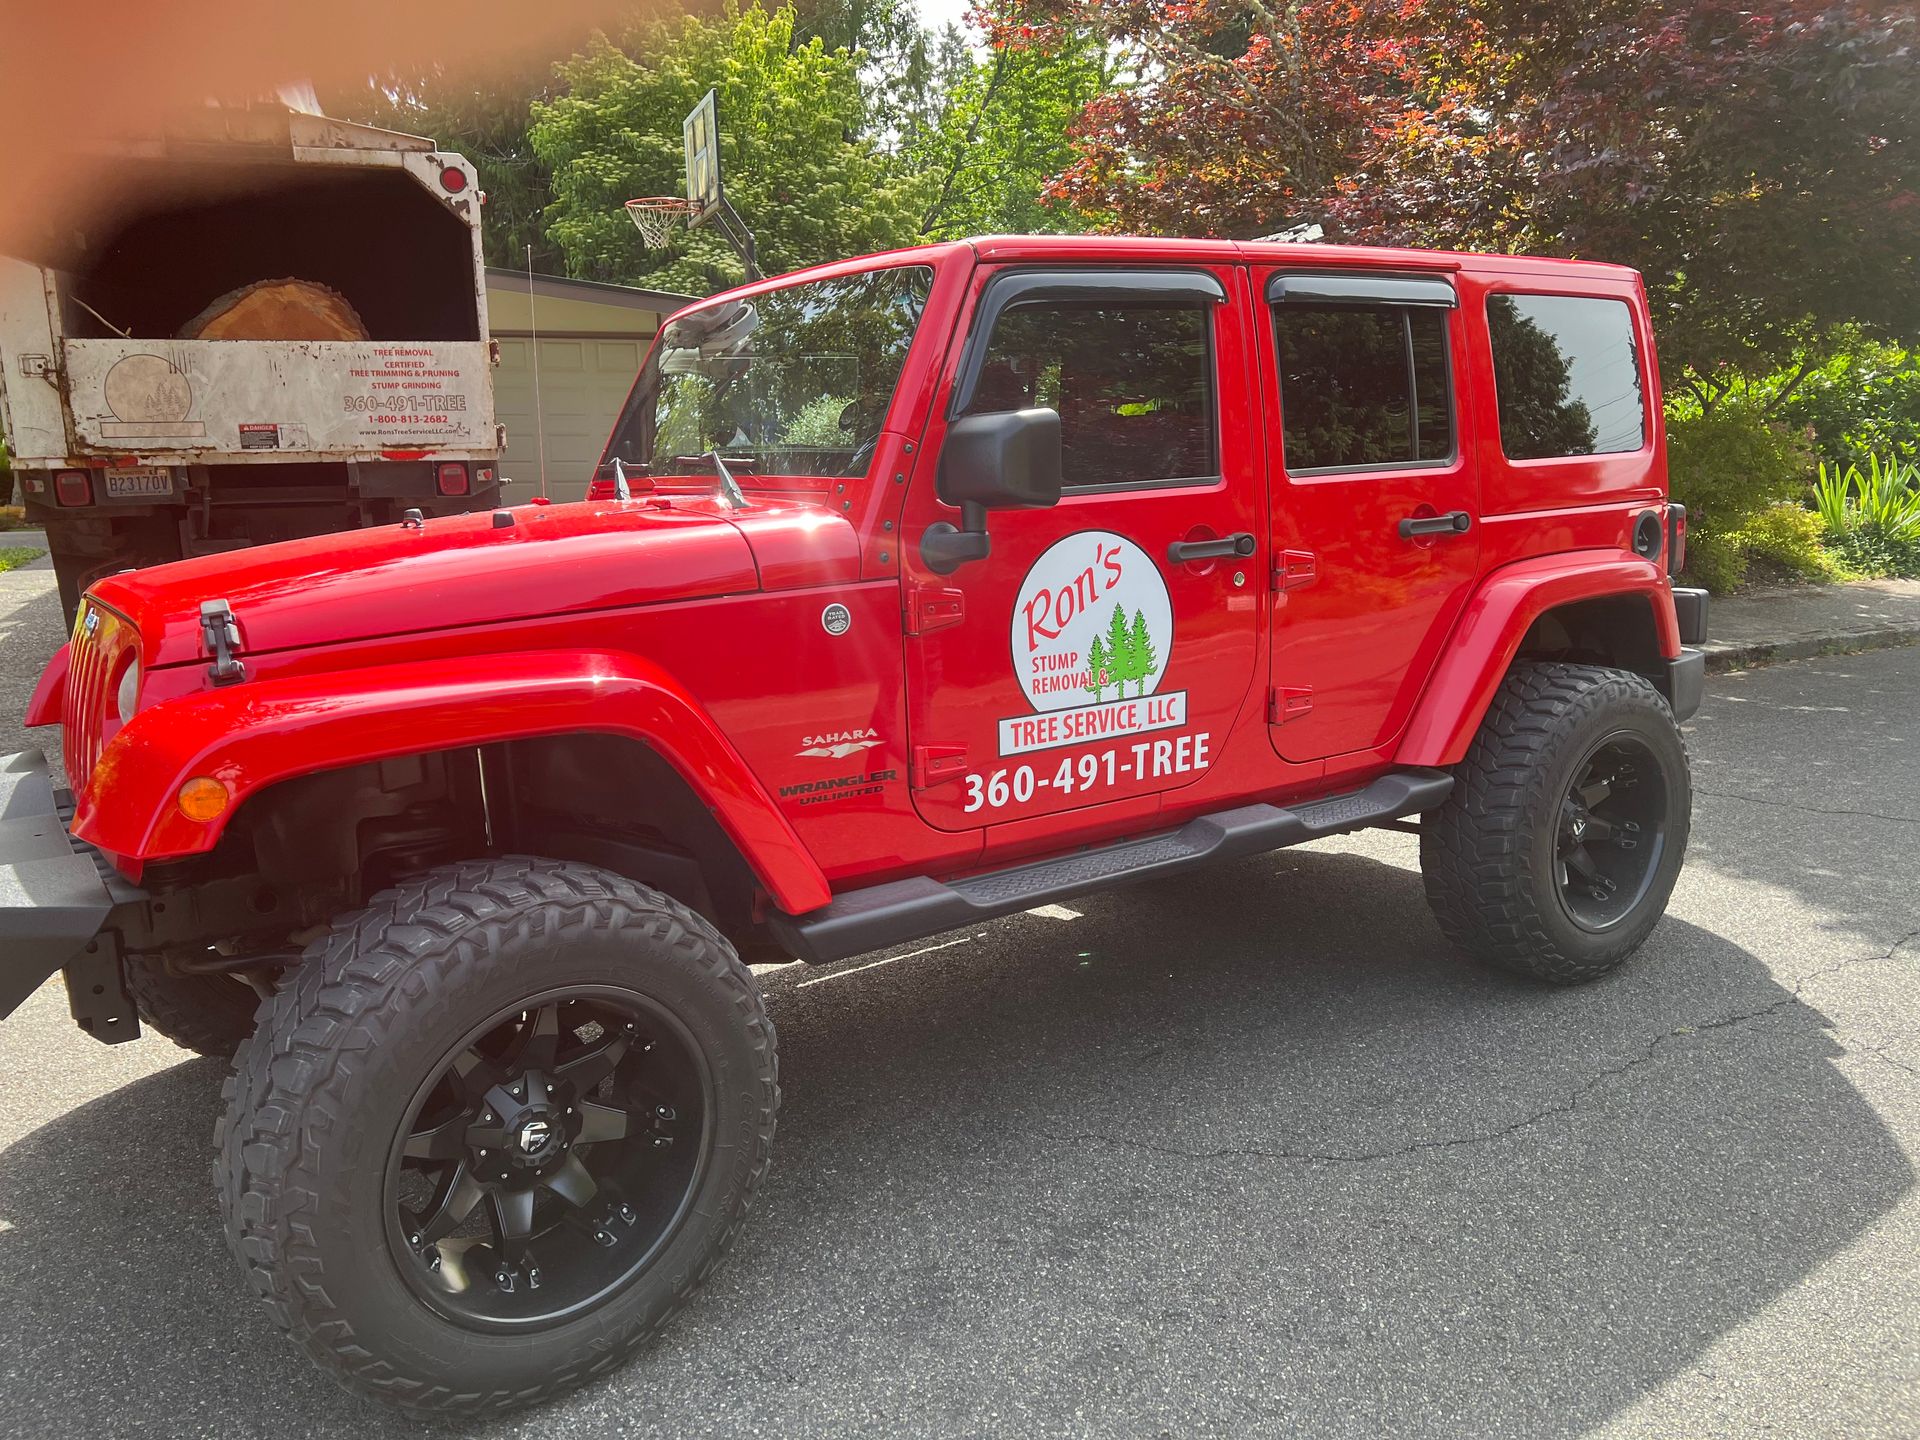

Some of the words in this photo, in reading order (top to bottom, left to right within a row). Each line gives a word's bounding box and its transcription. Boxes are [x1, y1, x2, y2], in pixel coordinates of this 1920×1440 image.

[373, 349, 393, 357] TREE
[394, 349, 434, 357] REMOVAL
[350, 369, 369, 377] TREE
[371, 369, 413, 377] TRIMMING
[422, 369, 460, 377] PRUNING
[343, 394, 467, 412] 360-491-TREE
[368, 415, 449, 424] 1-800-813-2682
[1022, 542, 1122, 653] Ron's
[1032, 652, 1079, 674] STUMP
[1032, 671, 1095, 696] REMOVAL
[1098, 668, 1109, 686] &
[1010, 716, 1058, 748] TREE
[1063, 703, 1143, 740] SERVICE,
[1148, 697, 1177, 725] LLC
[802, 728, 878, 747] SAHARA
[779, 769, 897, 798] WRANGLER
[963, 732, 1211, 814] 360-491-TREE
[799, 785, 885, 806] UNLIMITED
